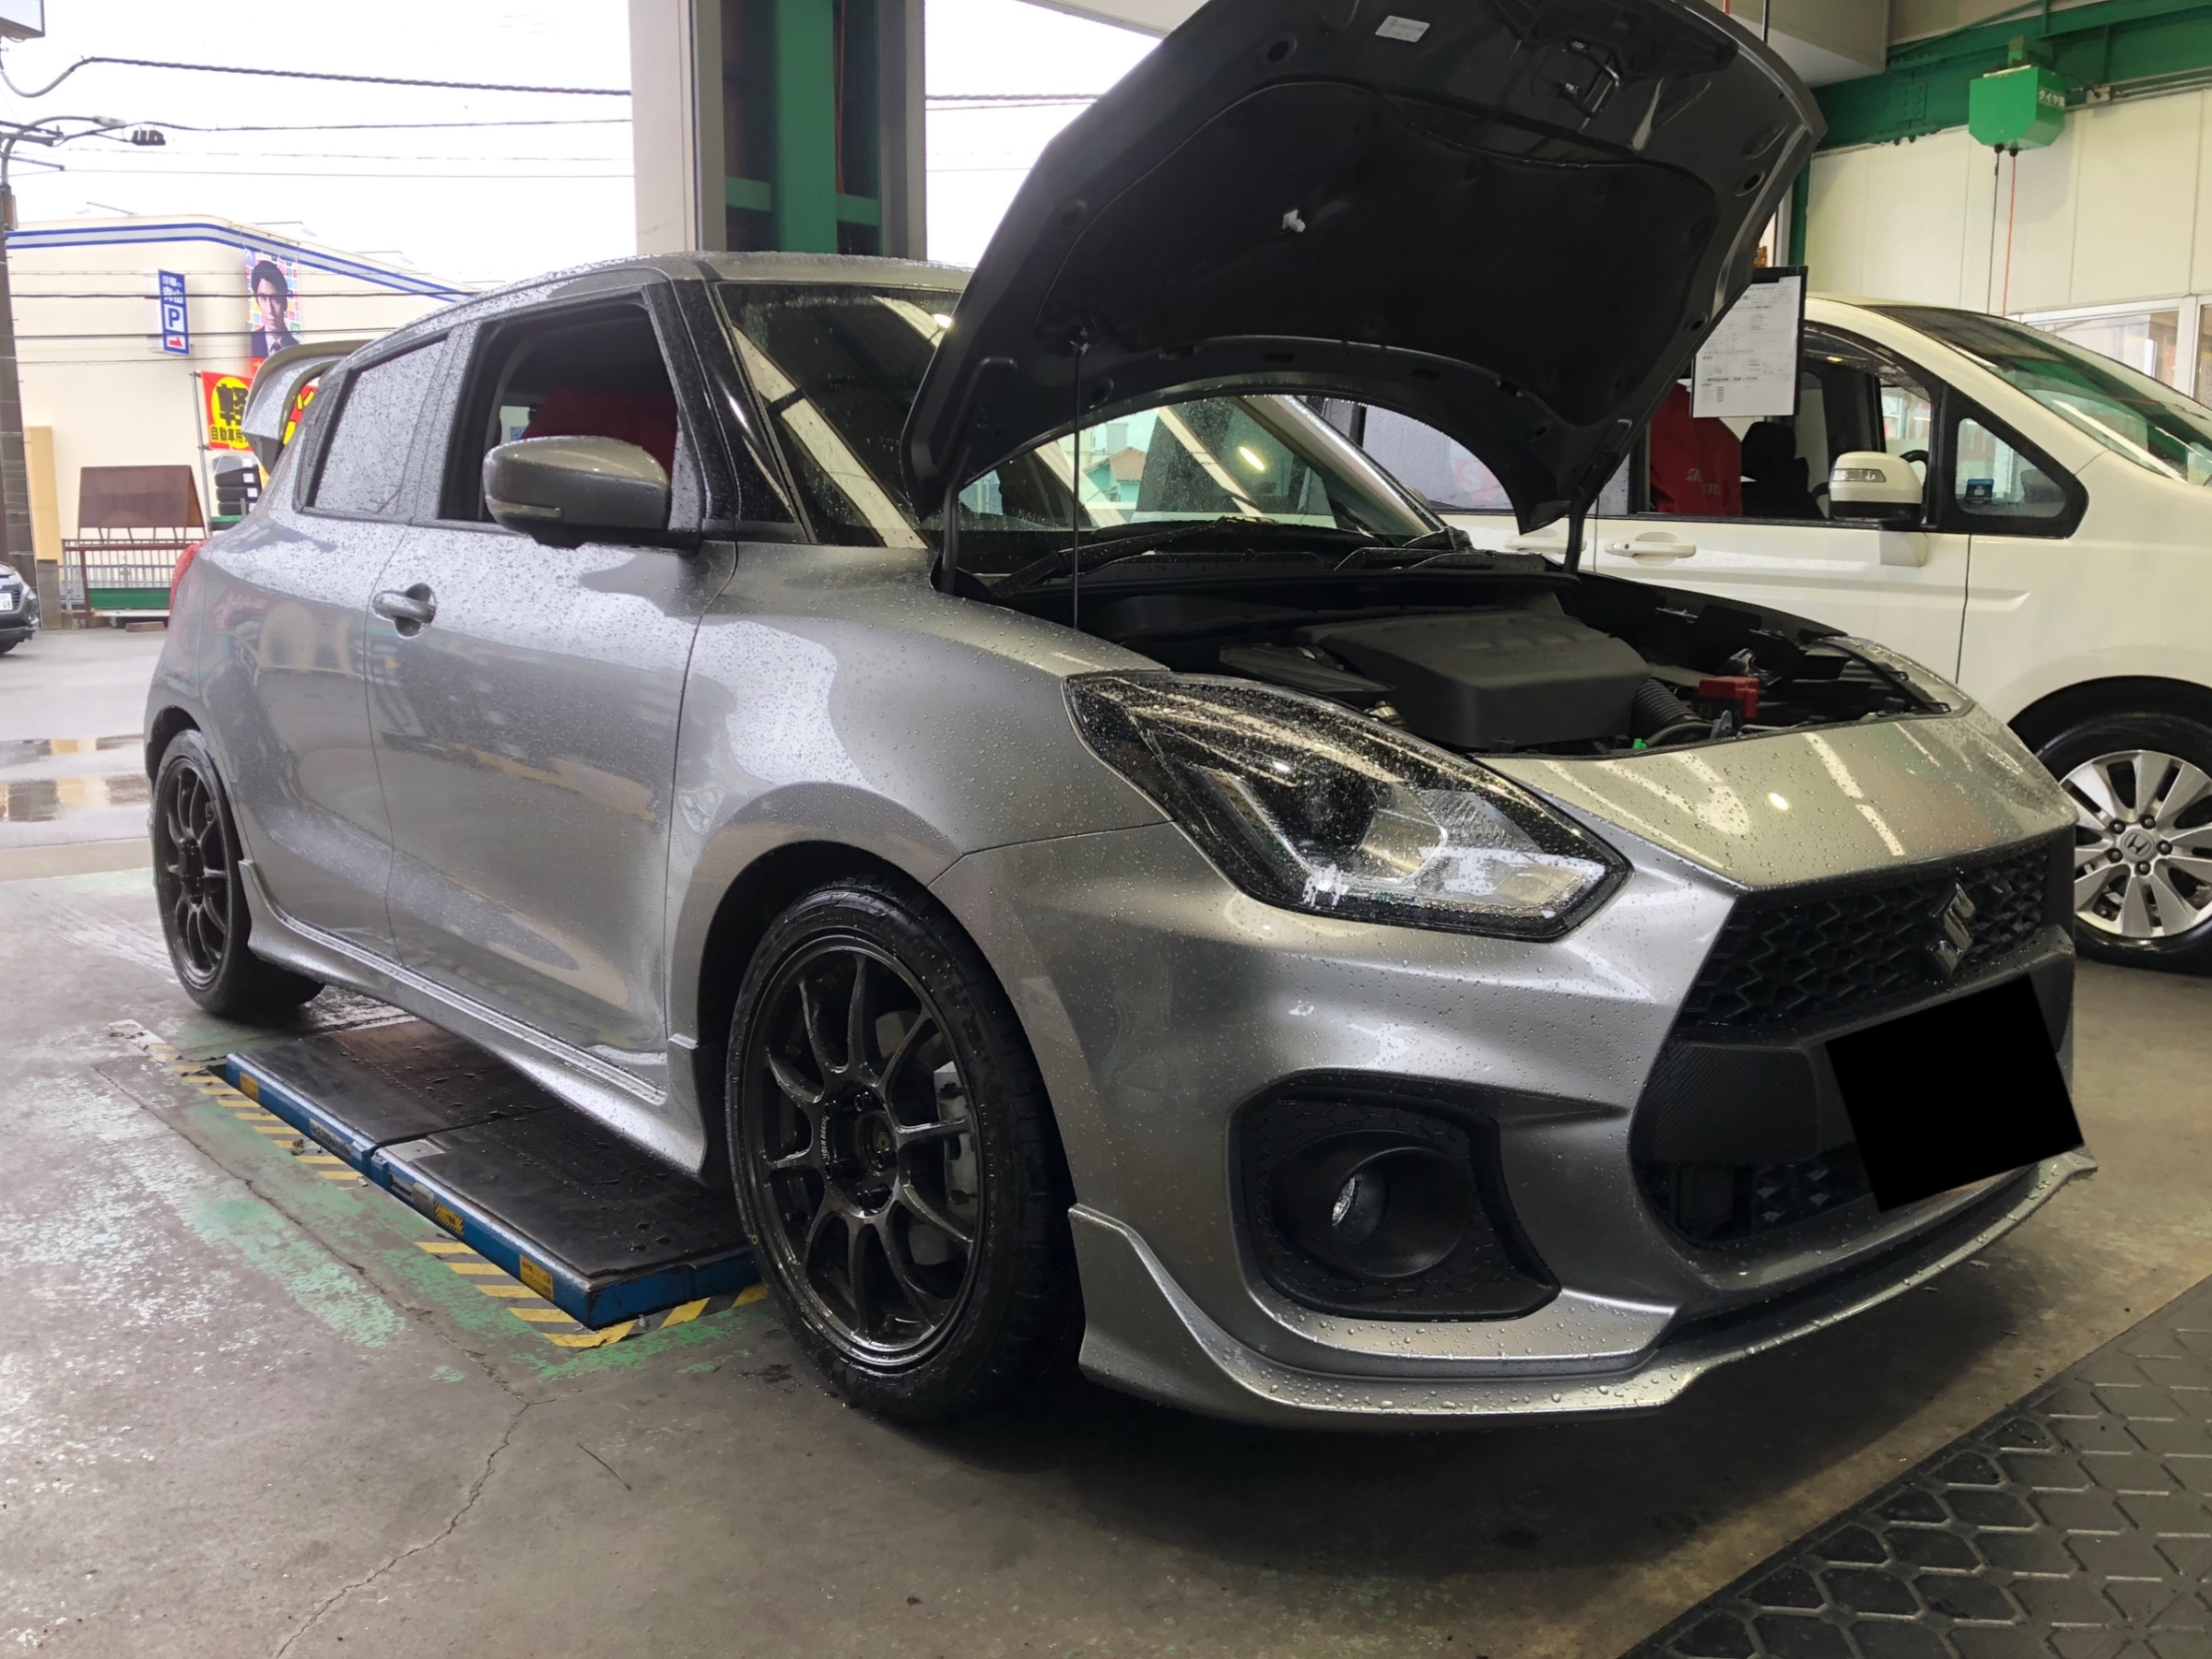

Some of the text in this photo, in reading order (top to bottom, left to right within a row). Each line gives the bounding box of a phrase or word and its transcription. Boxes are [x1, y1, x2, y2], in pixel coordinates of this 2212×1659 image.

[168, 307, 181, 327] P
[211, 427, 249, 443] 自動車用
